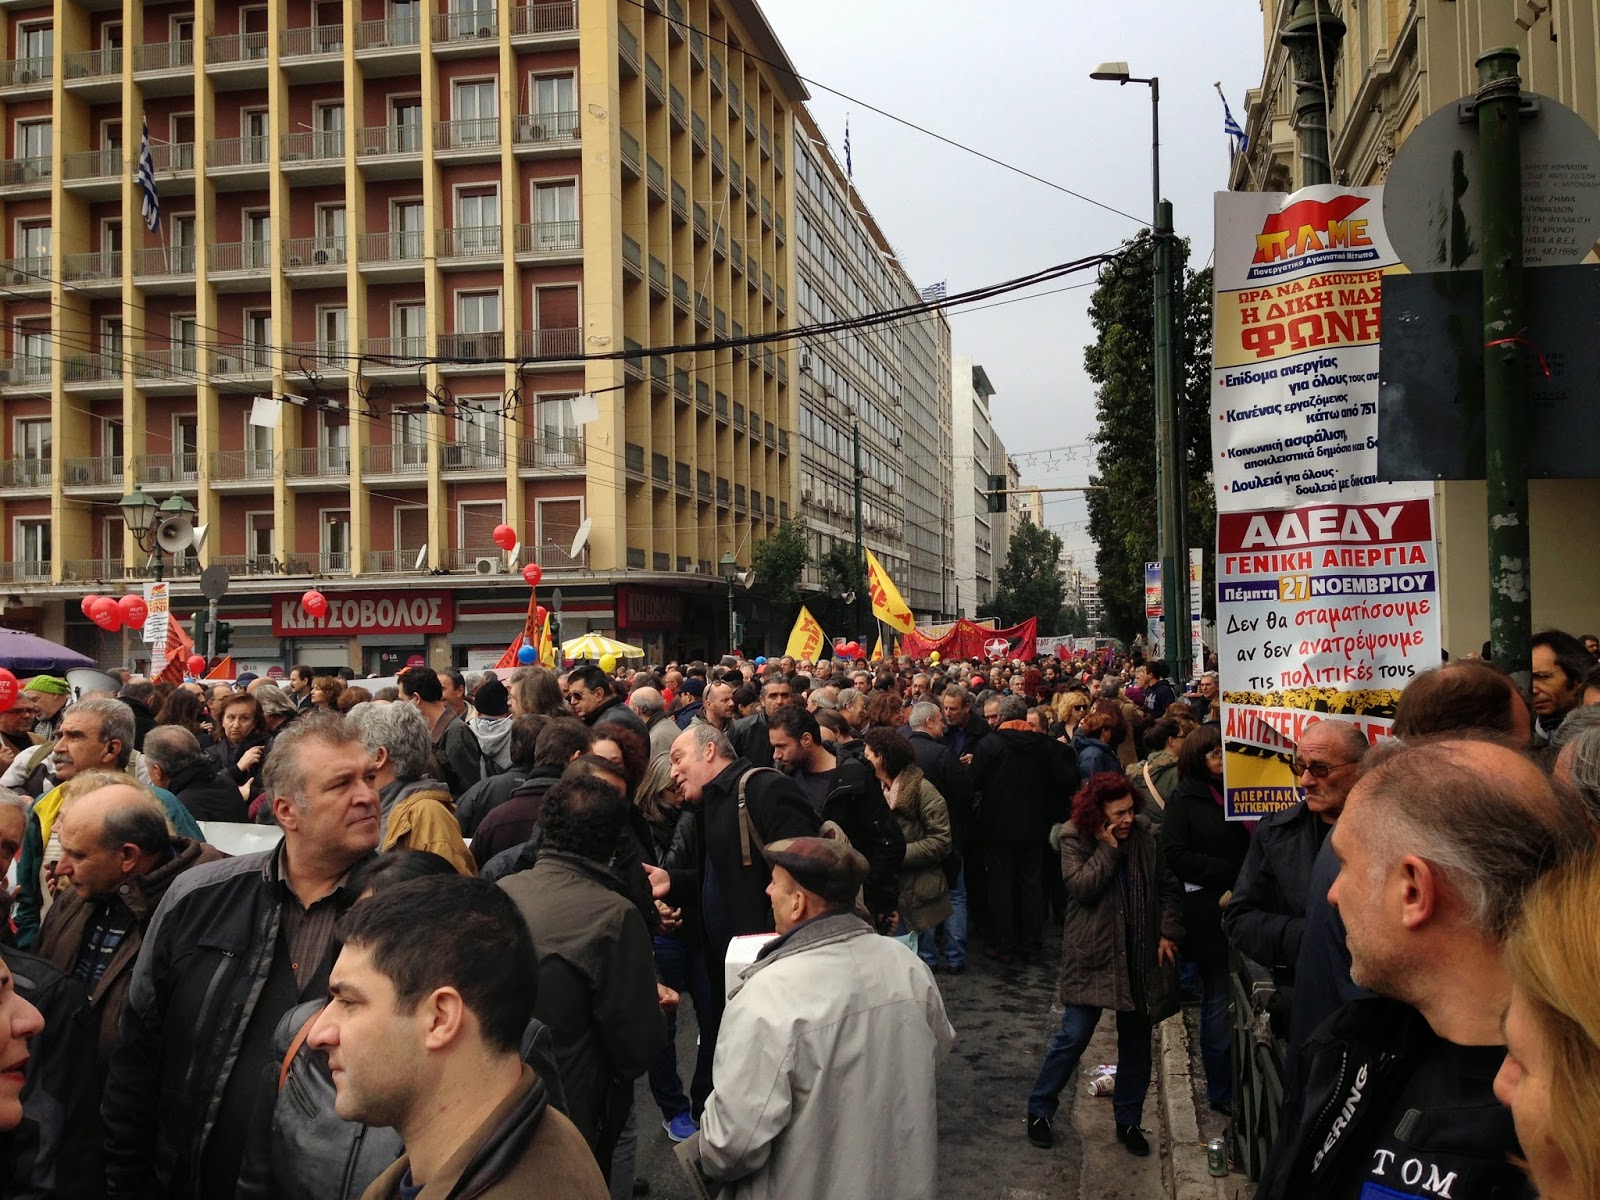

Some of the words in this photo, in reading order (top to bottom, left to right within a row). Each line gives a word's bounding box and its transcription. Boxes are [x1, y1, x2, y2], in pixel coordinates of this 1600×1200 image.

[1528, 205, 1574, 213] ΠΙΝΑΚΙΔΩΝ
[1548, 195, 1576, 203] ΖΗΜΙΑ
[1542, 226, 1576, 234] ΧΡΟΝΟΥ
[1253, 258, 1304, 276] Πανεργατικό
[1306, 251, 1345, 265] Αγωνιστικό
[1541, 247, 1579, 256] 4831996
[1238, 289, 1273, 304] ΩΡΑ
[1277, 282, 1304, 297] ΝΑ
[1241, 307, 1260, 325] Η
[1266, 291, 1334, 321] ΔΙΚΗ
[1338, 286, 1381, 306] ΜΑΣ
[1241, 307, 1381, 358] ΦΩΝΗ
[1225, 369, 1277, 387] Επίδομα
[1280, 356, 1338, 377] ανεργίας
[1288, 379, 1310, 396] για
[1312, 374, 1347, 389] όλους
[1348, 373, 1365, 383] τους
[1227, 403, 1281, 422] Κανένας
[1284, 393, 1348, 412] εργαζόμενος
[1306, 407, 1339, 423] κάτω
[1341, 404, 1359, 420] από
[1360, 402, 1376, 415] 751
[1227, 439, 1283, 458] Κοινωνική
[1244, 448, 1314, 469] αποκλειστικά
[1317, 443, 1351, 458] δημόσια
[1351, 442, 1364, 451] και
[1231, 472, 1282, 493] Δουλειά
[1284, 474, 1300, 485] για
[1296, 481, 1337, 496] δουλειά
[1338, 477, 1349, 491] με
[1240, 505, 1404, 549] ΑΔΕΔΥ
[1225, 551, 1312, 575] ΓΕΝΙΚΗ
[1322, 545, 1426, 568] ΑΠΕΡΓΙΑ
[1224, 587, 1278, 602] Πέμπτη
[1282, 575, 1309, 600] 27
[1311, 574, 1428, 595] ΝΟΕΜΒΡΙΟΥ
[1226, 614, 1259, 634] Δεν
[1265, 610, 1288, 630] θα
[1295, 599, 1431, 632] σταματήσουμε
[1237, 647, 1256, 662] αν
[1263, 641, 1293, 659] δεν
[1299, 629, 1424, 660] ανατρέψουμε
[1249, 675, 1274, 689] τις
[1281, 659, 1374, 688] πολιτικές
[1378, 664, 1416, 679] τους
[1311, 1063, 1369, 1174] BERING
[1372, 1149, 1458, 1199] TOM
